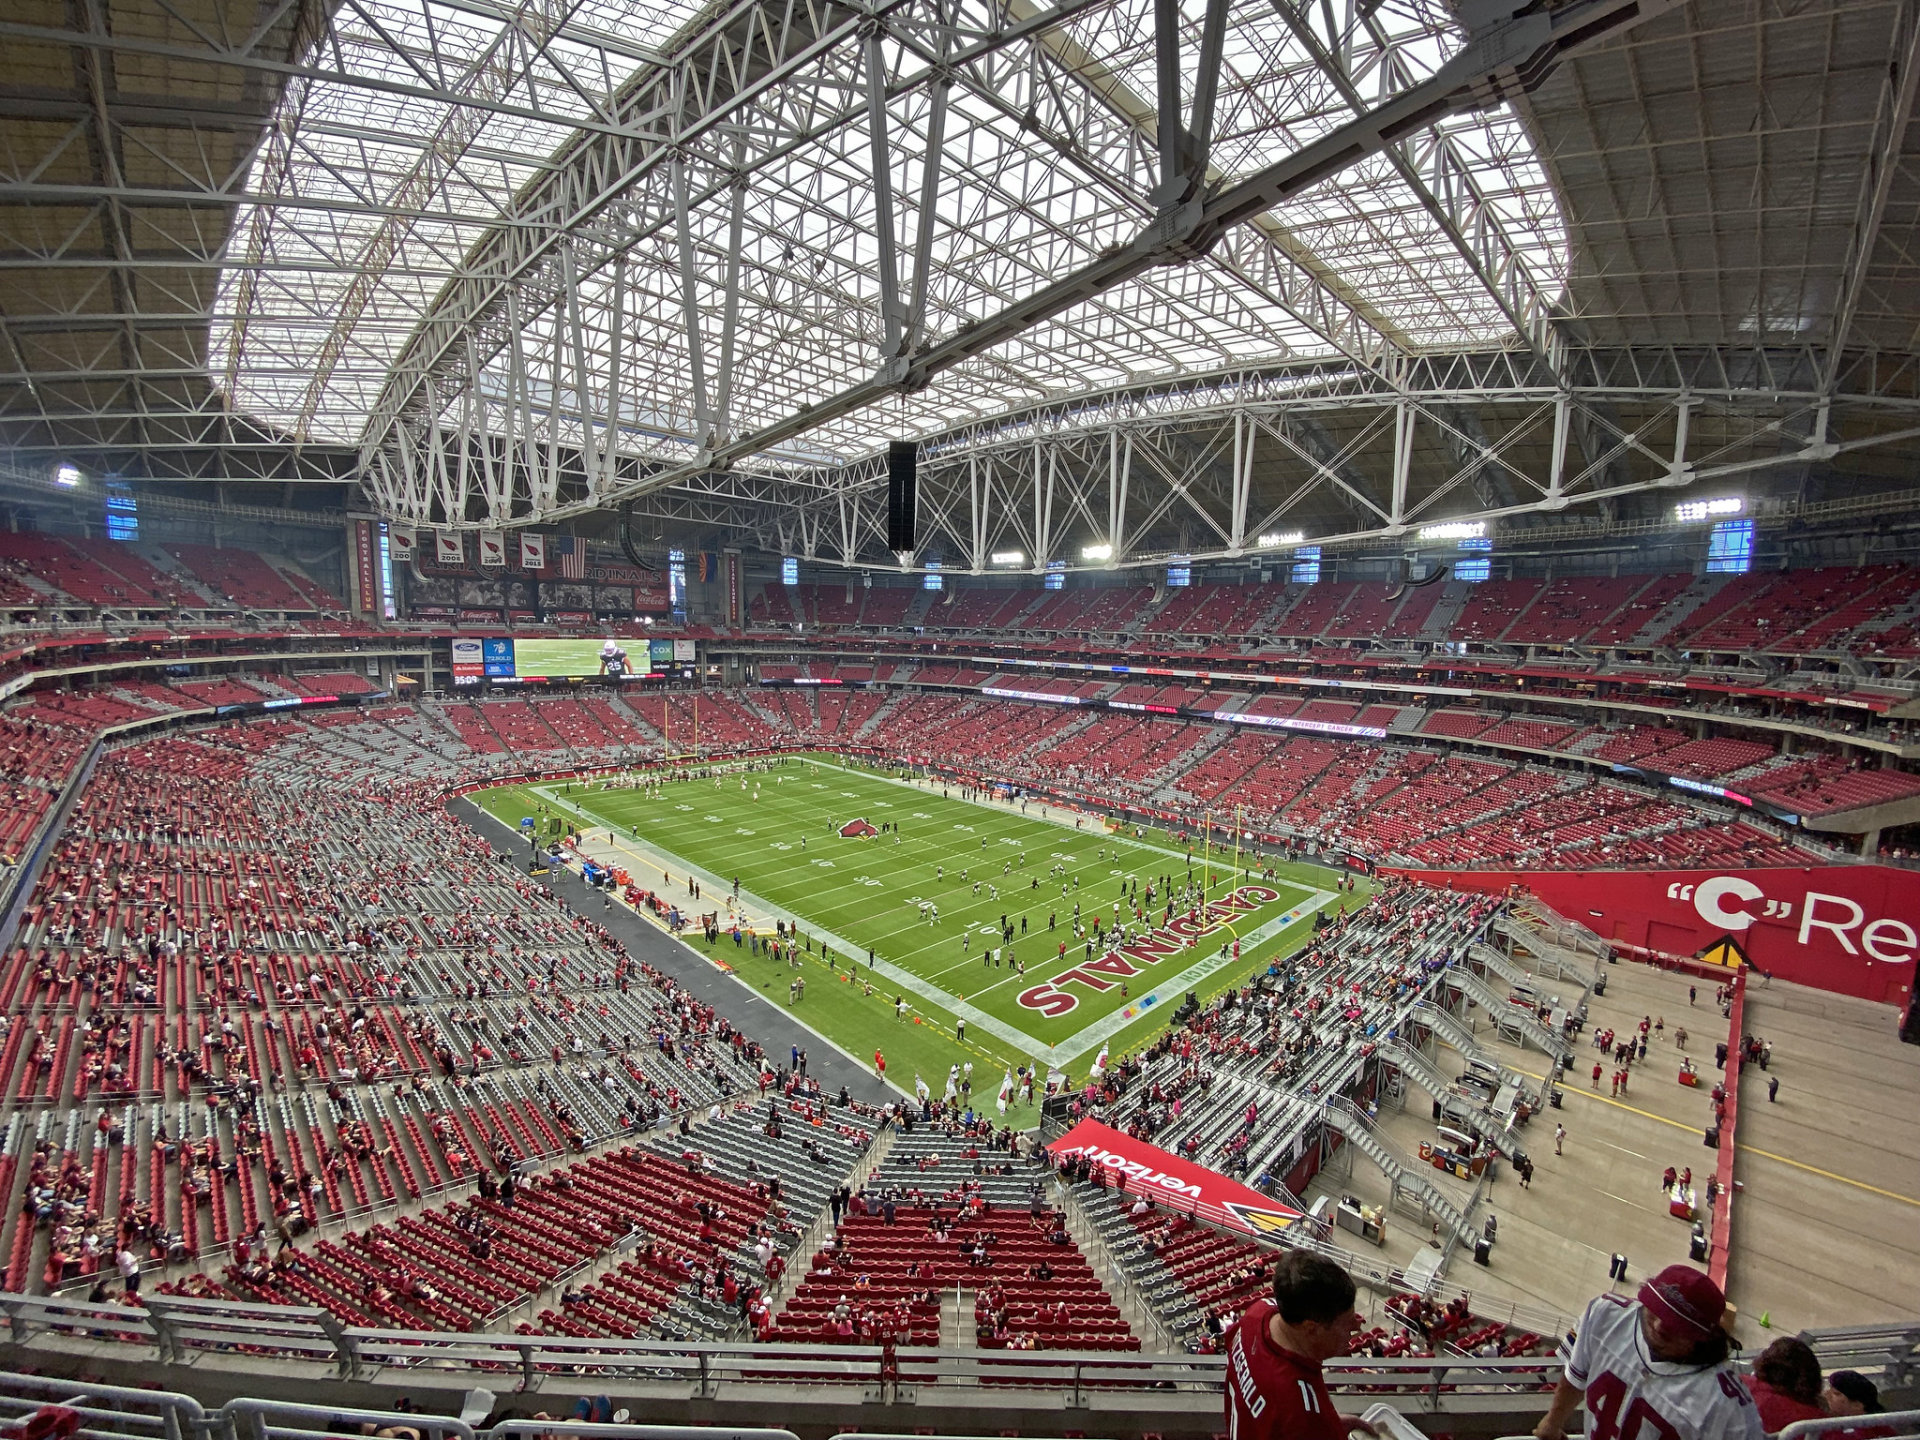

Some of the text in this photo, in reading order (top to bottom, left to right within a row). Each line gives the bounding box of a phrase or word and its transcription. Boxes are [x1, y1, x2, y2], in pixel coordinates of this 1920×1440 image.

[361, 529, 372, 609] FOOTBALL CLUB
[423, 557, 662, 583] ARIONA CRDINALS
[636, 594, 667, 605] Coca-Cola
[653, 646, 671, 654] COX
[607, 662, 621, 671] 25
[1291, 721, 1354, 733] INTERCEPT CANCER
[1798, 891, 1918, 963] Re
[1016, 886, 1281, 1018] CARDINALS
[1180, 957, 1223, 983] CATCH
[1060, 1144, 1203, 1198] verizon
